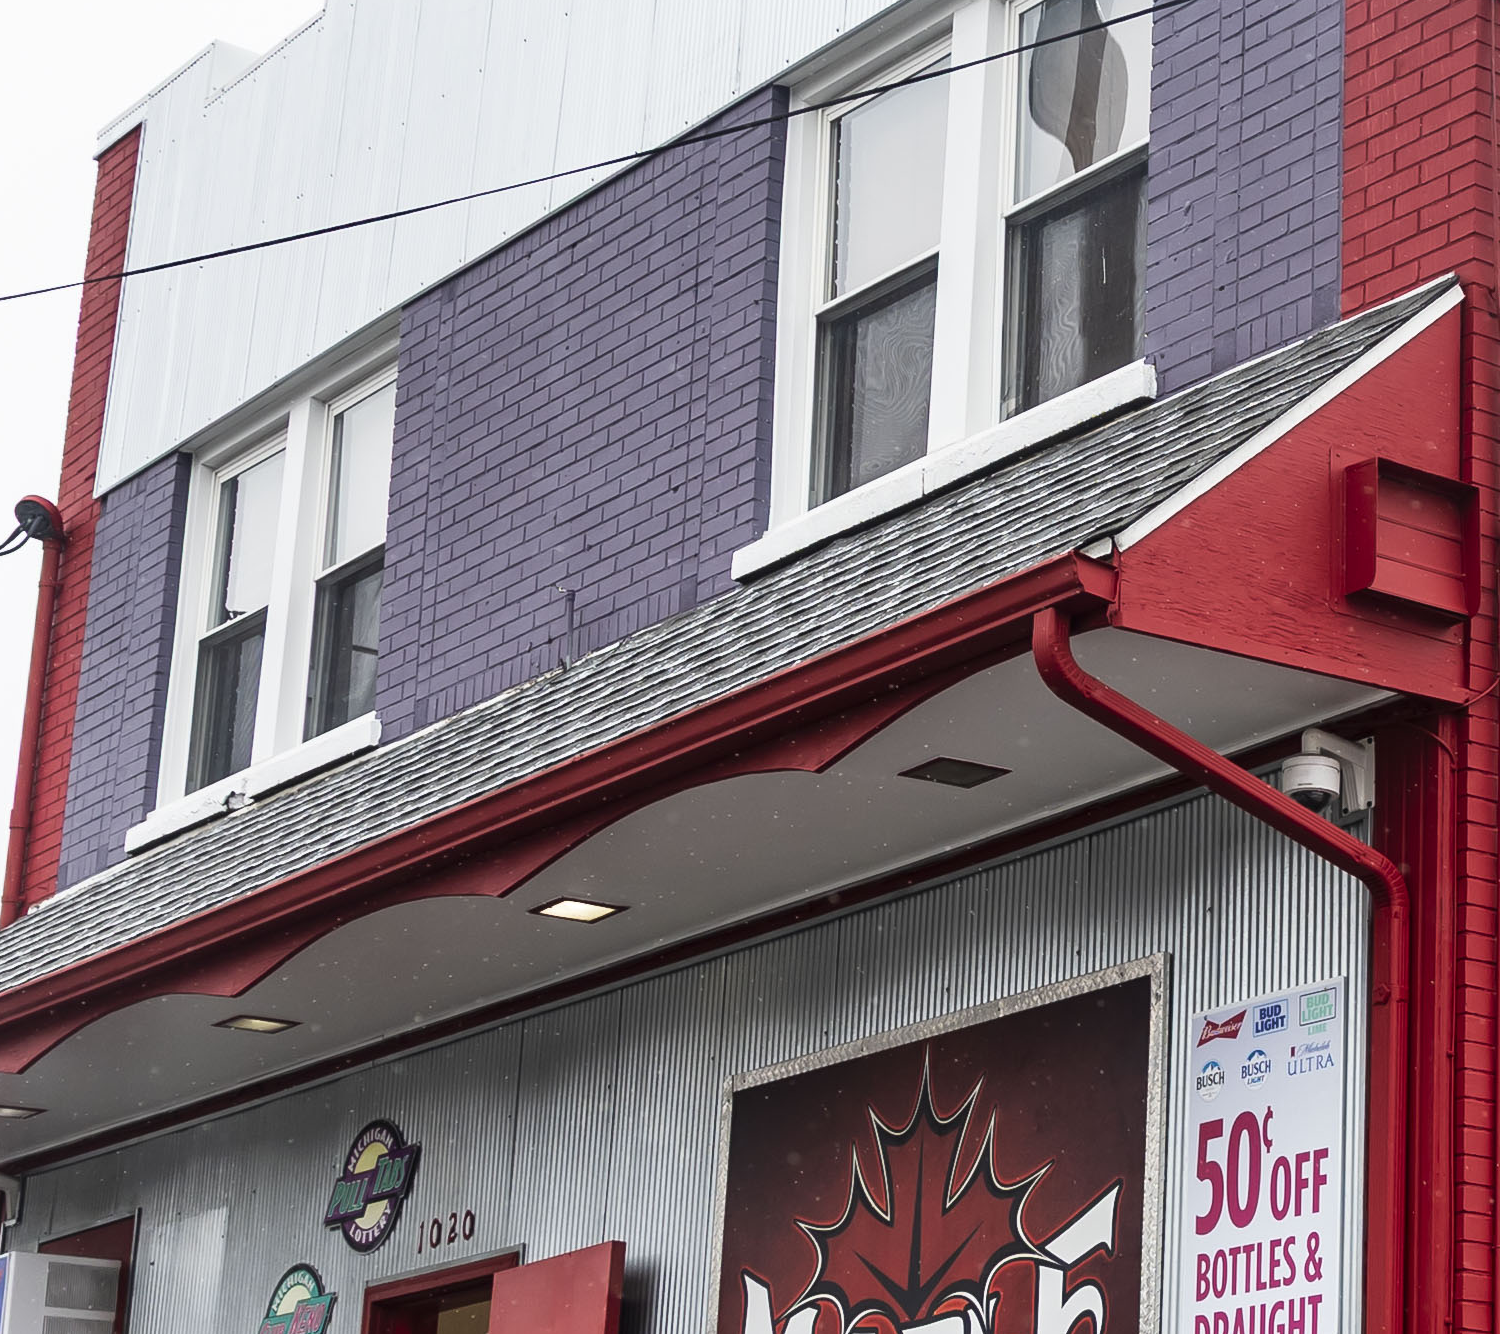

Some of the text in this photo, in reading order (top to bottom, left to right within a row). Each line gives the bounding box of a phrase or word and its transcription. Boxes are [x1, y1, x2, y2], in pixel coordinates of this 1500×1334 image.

[1306, 993, 1330, 1008] BUD
[1259, 1004, 1282, 1020] BUD
[1301, 1004, 1334, 1023] LIGHT
[1201, 1021, 1242, 1040] Budweiser
[1255, 1015, 1286, 1034] LIGHT
[1307, 1023, 1328, 1036] LIME
[1241, 1059, 1271, 1080] BUSCH
[1287, 1053, 1335, 1076] ULTRA
[1196, 1070, 1225, 1091] BUSCH
[1247, 1074, 1266, 1085] LIGHT
[348, 1127, 393, 1172] MICHIGAN
[327, 1154, 410, 1218] PULL TABS
[1269, 1147, 1329, 1221] OFF
[349, 1203, 392, 1244] LOTTERY
[417, 1209, 476, 1255] 1020
[1195, 1231, 1323, 1302] BOTTLES &
[271, 1271, 315, 1313] MICHIGAN
